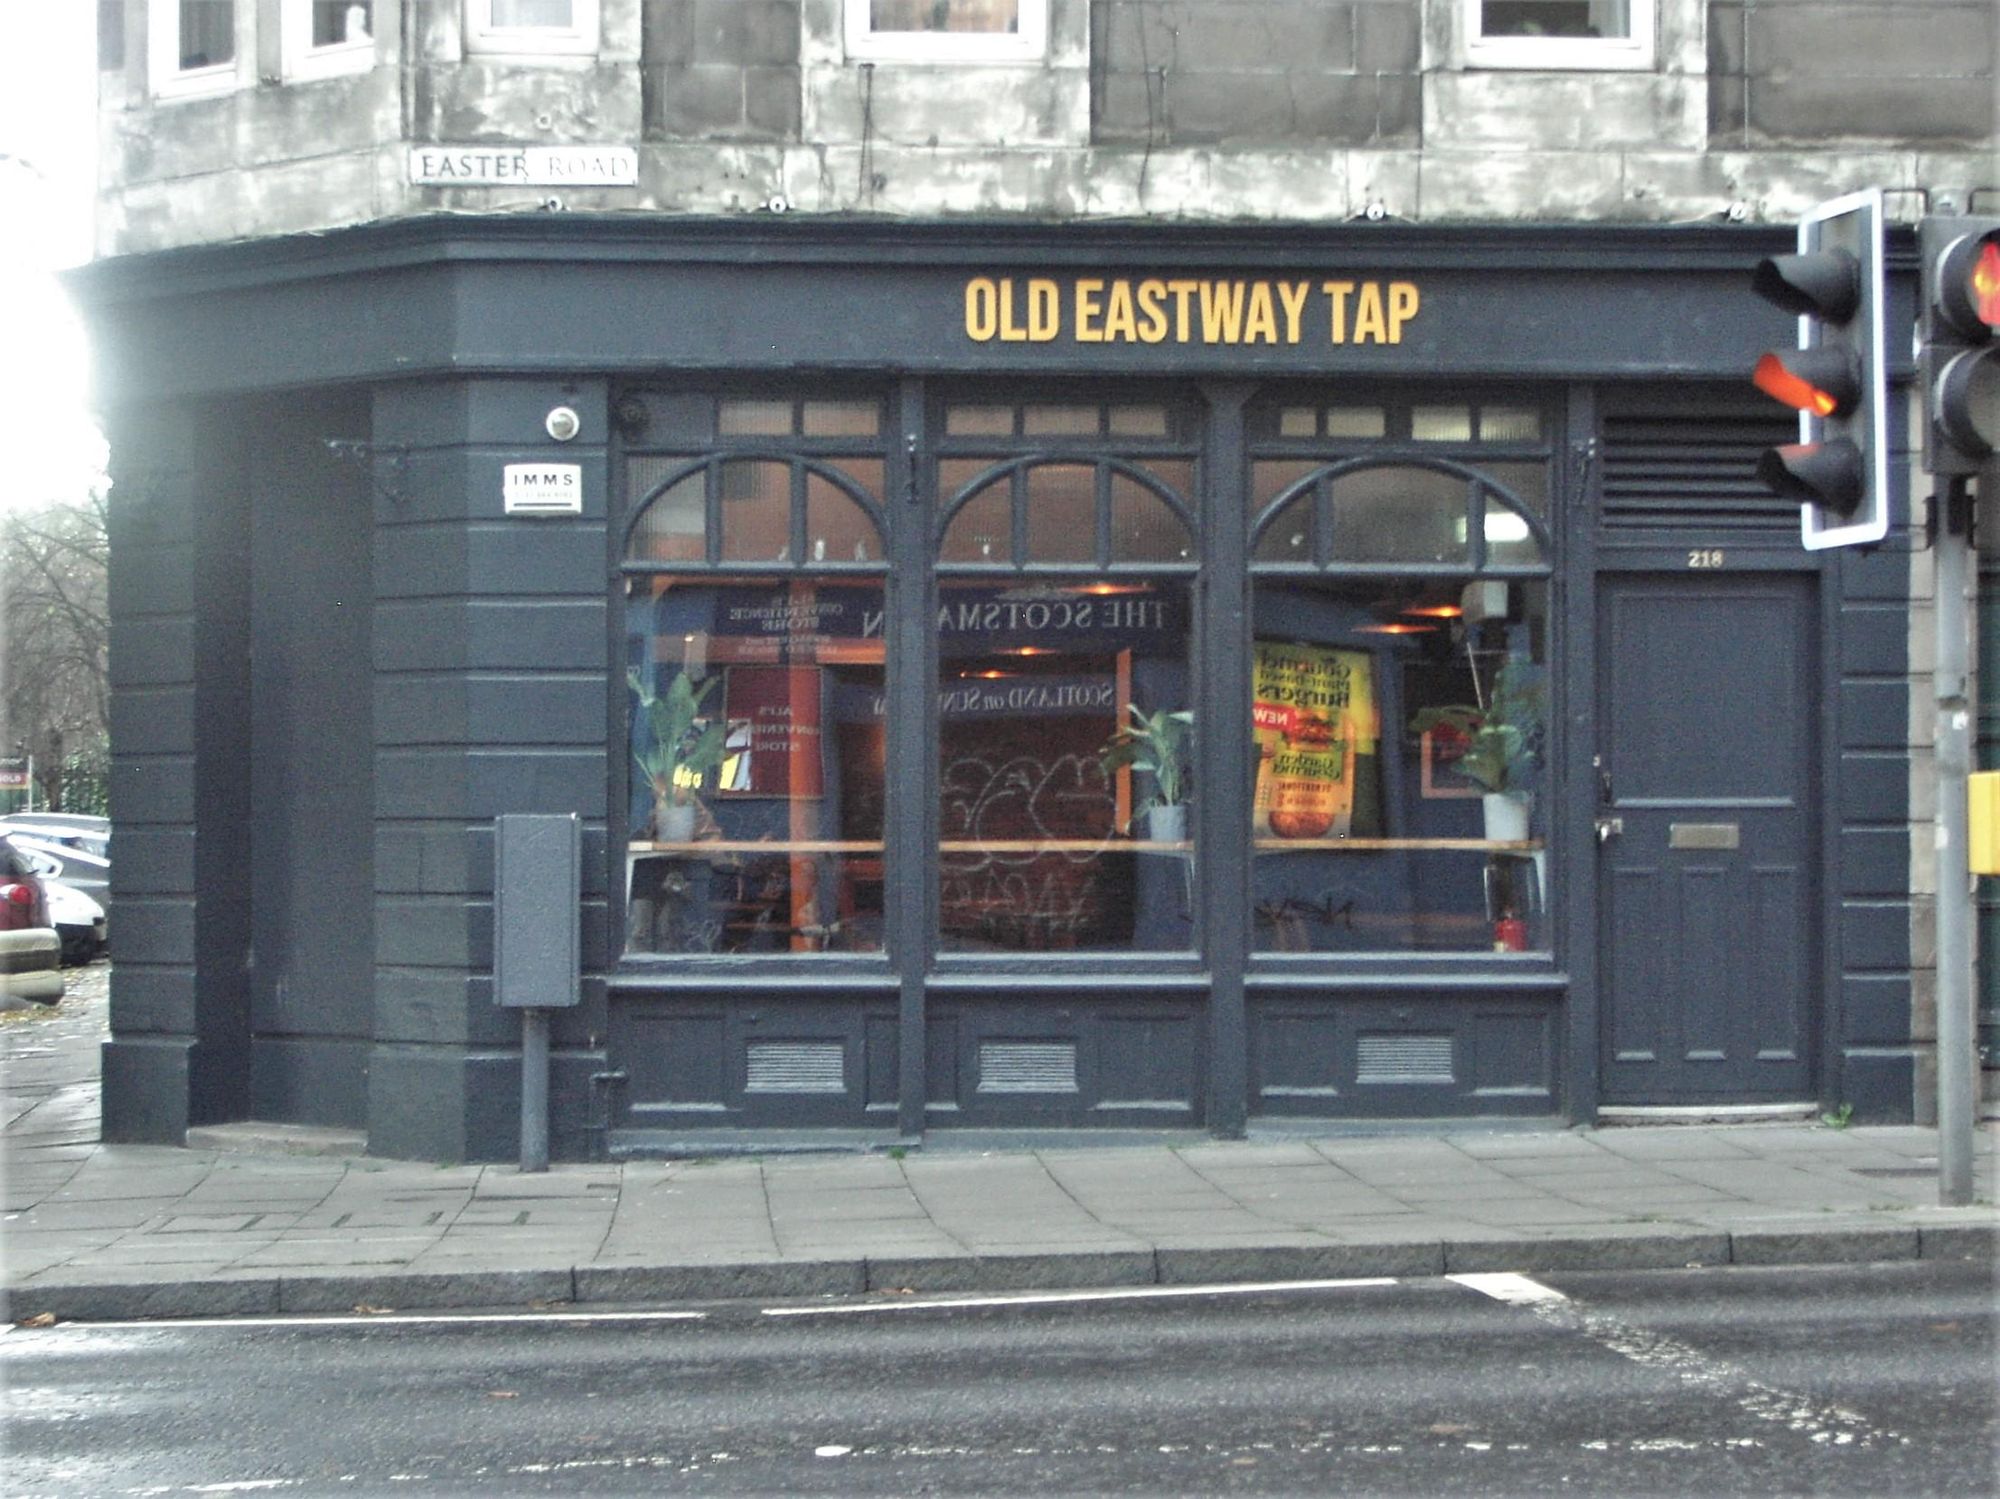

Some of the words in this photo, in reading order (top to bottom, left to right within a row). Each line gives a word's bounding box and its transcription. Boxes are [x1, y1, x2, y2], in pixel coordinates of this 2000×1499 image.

[422, 155, 530, 178] EASTER
[549, 156, 629, 177] ROAD
[964, 278, 1060, 342] OLD
[1074, 279, 1310, 344] EASTWAY
[1323, 281, 1420, 345] TAP
[513, 473, 573, 487] IMMS
[1688, 550, 1723, 568] 218
